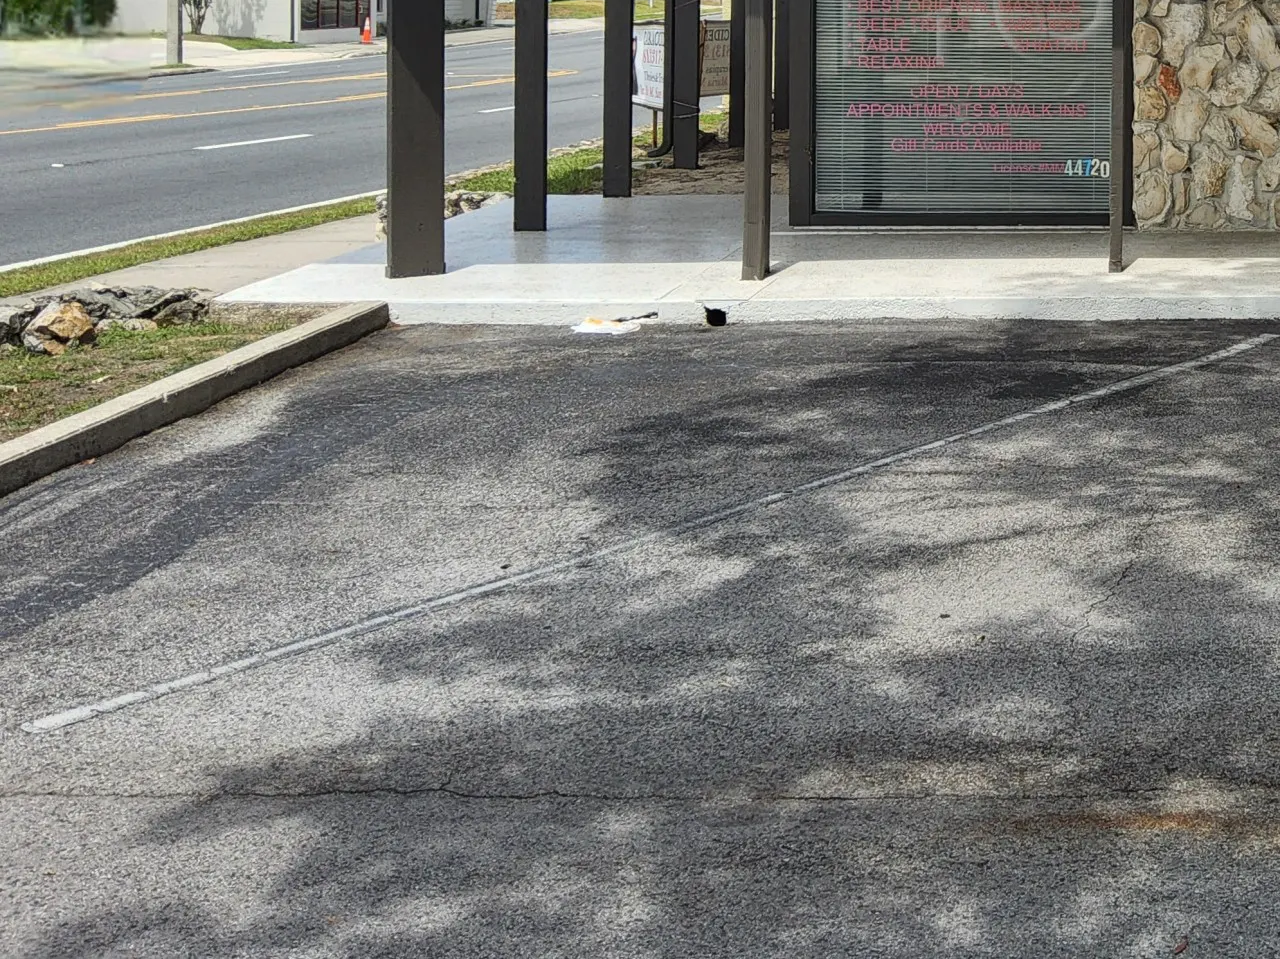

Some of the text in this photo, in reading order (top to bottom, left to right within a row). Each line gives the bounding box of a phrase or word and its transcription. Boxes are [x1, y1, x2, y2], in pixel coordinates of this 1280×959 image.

[858, 38, 911, 52] TABLE
[858, 55, 945, 68] RELAXING
[846, 103, 983, 118] APPOINTMENTS
[922, 122, 1013, 136] WELCOME
